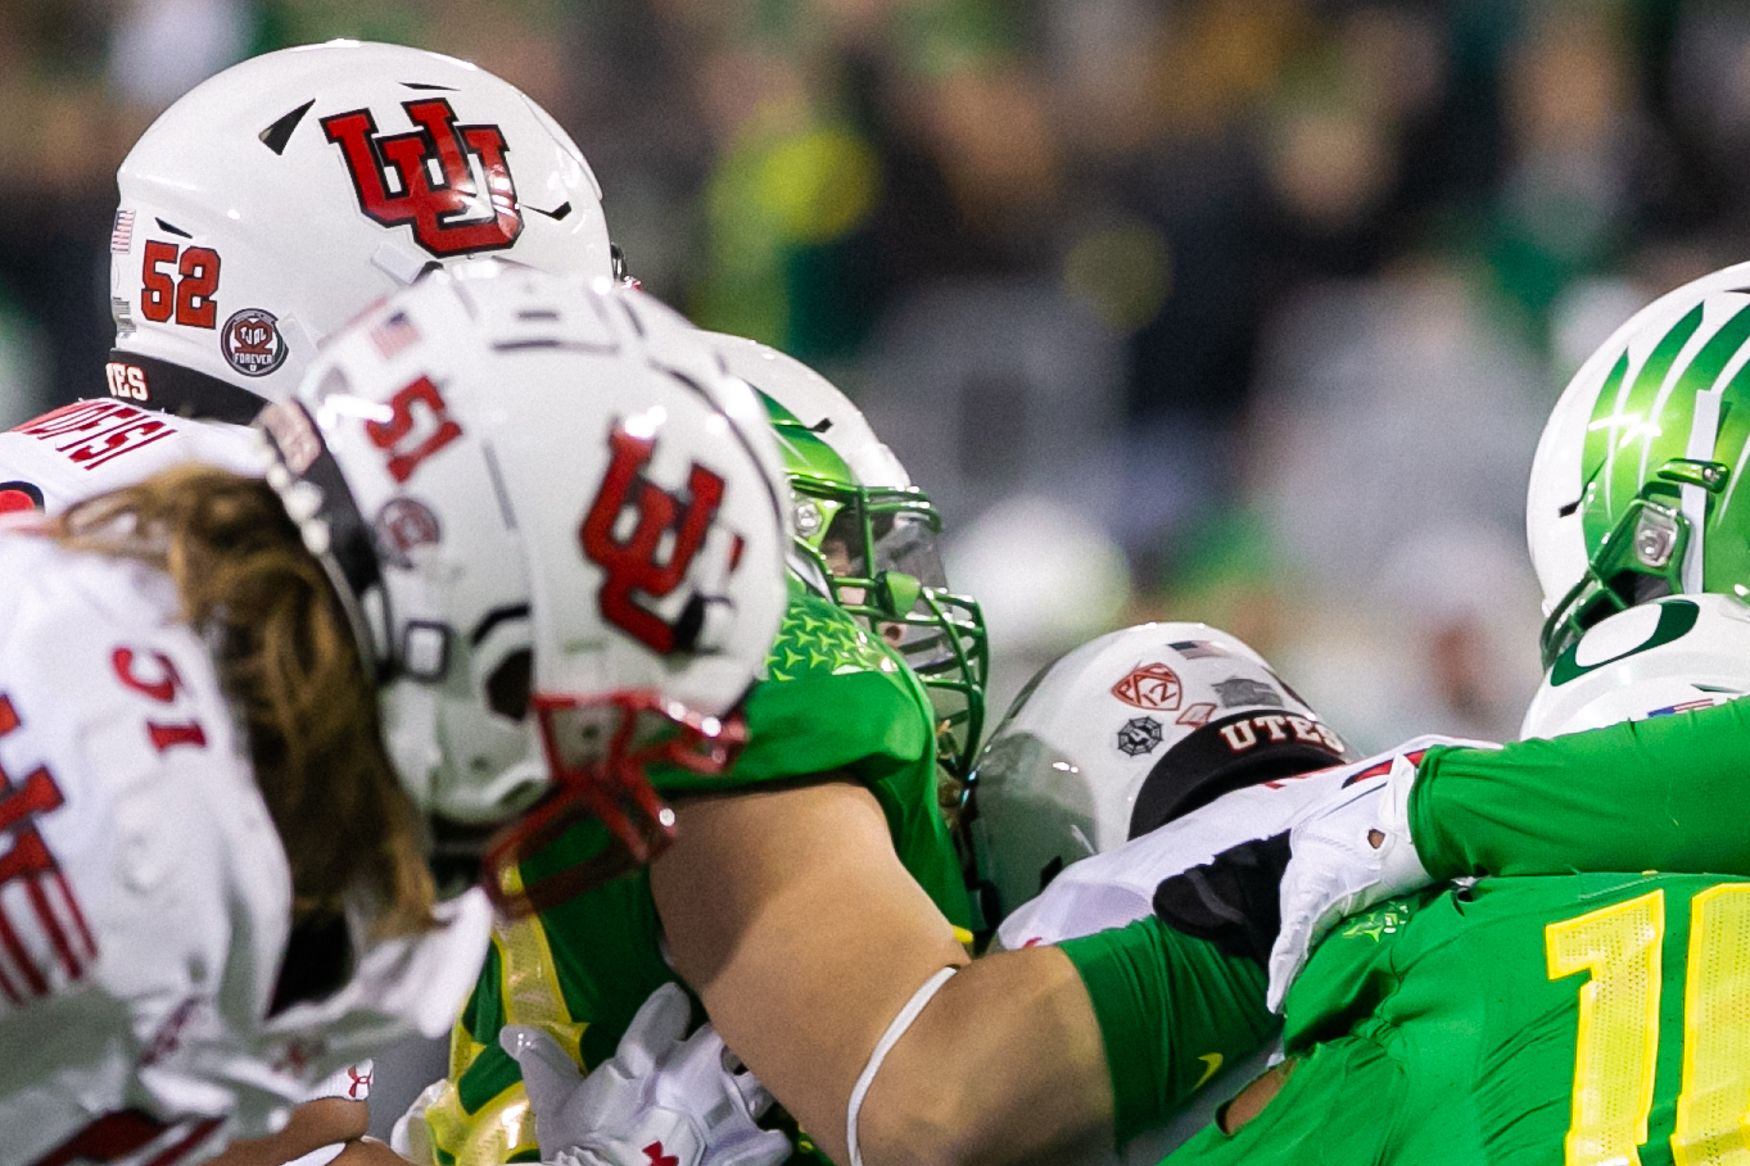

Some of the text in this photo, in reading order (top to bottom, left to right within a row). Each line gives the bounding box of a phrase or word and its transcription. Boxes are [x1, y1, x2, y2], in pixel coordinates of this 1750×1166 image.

[141, 239, 221, 330] 52
[234, 353, 275, 365] FOREVER
[365, 374, 463, 485] 51
[112, 646, 207, 752] 51
[1219, 716, 1346, 753] UTES
